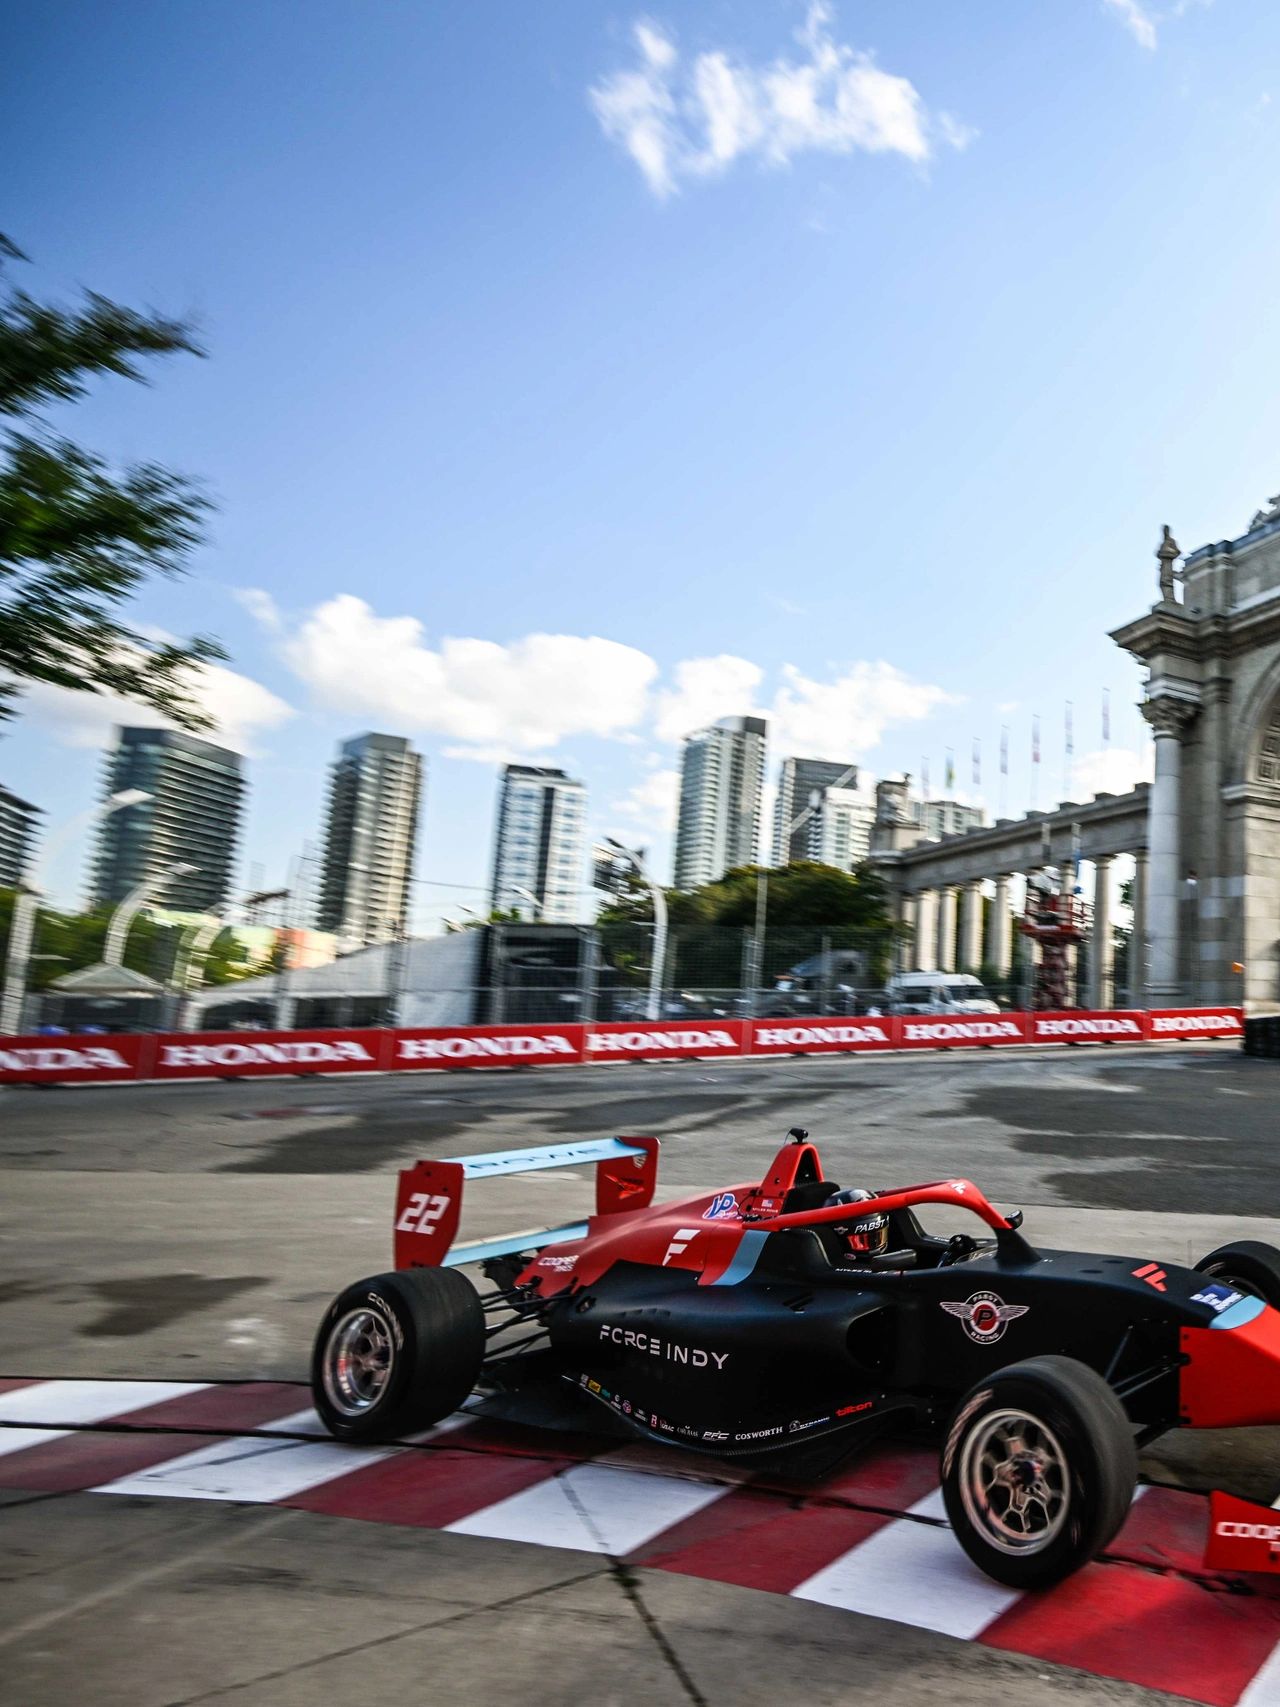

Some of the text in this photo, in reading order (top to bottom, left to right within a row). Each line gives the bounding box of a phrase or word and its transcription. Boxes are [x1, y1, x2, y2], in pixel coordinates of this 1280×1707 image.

[903, 1021, 1023, 1040] HONDA
[1035, 1018, 1142, 1036] HONDA
[1151, 1014, 1243, 1032] HONDA
[585, 1030, 738, 1052] HONDA
[754, 1025, 890, 1047] HONDA
[162, 1041, 375, 1067] HONDA
[399, 1035, 578, 1060] HONDA
[395, 1192, 450, 1236] 22
[854, 1218, 886, 1234] PABST
[666, 1343, 729, 1370] INDY
[735, 1426, 783, 1441] COSWORTH
